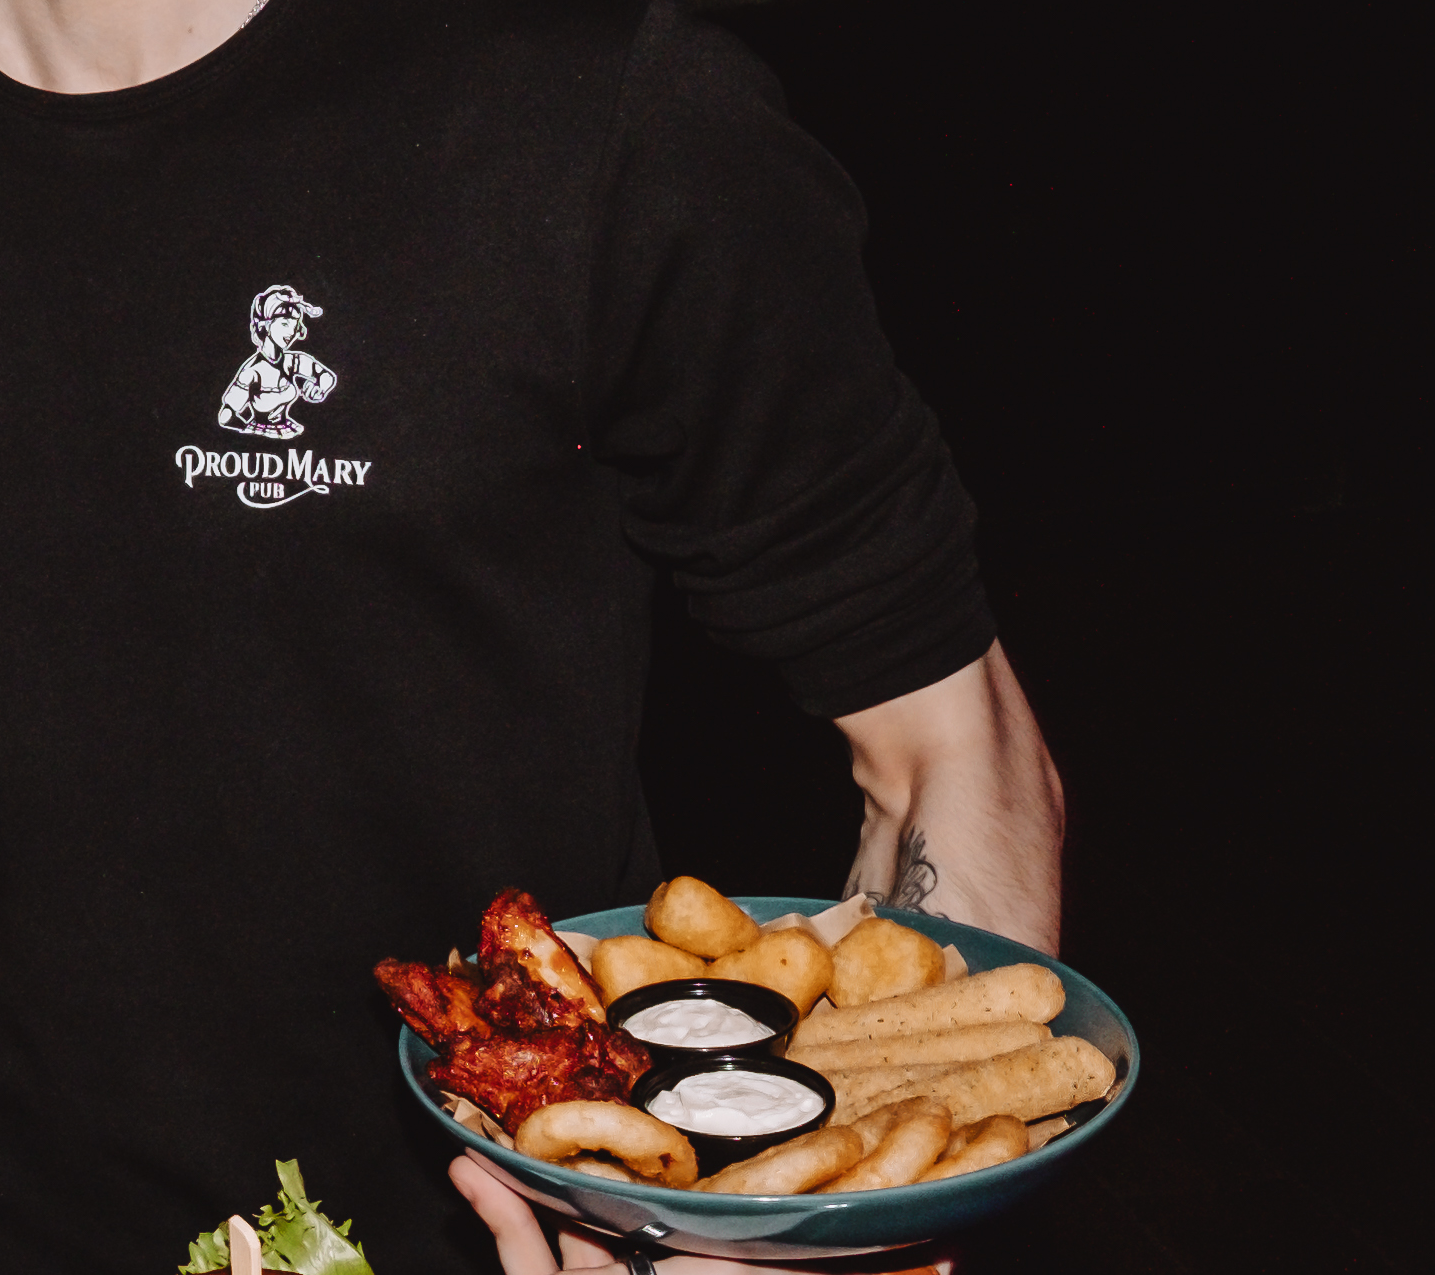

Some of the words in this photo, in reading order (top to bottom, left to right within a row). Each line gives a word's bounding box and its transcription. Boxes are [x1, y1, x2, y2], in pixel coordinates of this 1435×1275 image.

[175, 445, 284, 488] PROUD
[287, 448, 372, 486] MARY
[249, 482, 285, 498] PUB
